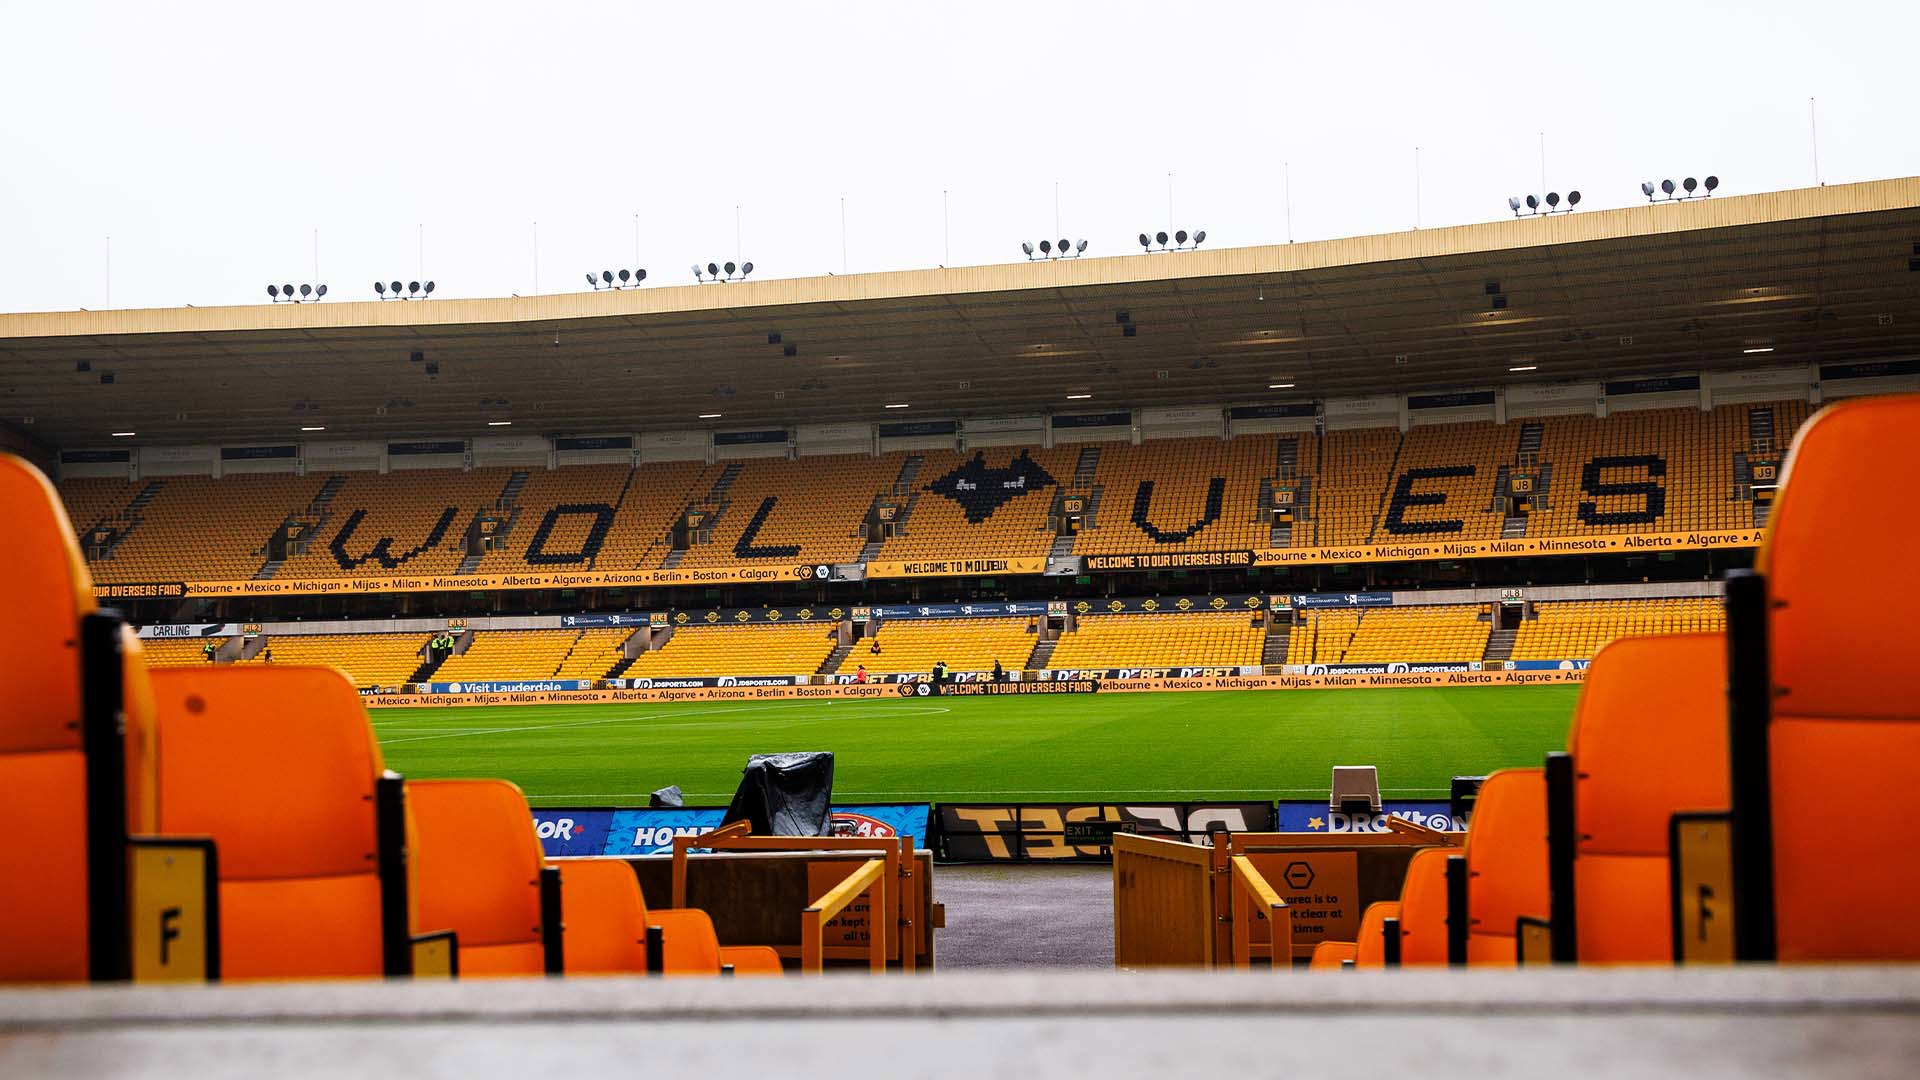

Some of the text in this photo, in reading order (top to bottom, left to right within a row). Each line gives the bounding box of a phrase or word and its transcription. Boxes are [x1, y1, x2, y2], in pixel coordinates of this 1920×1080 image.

[1759, 468, 1772, 477] J9
[1516, 481, 1529, 490] J8
[1279, 493, 1290, 502] J7
[1068, 502, 1079, 511] J6
[883, 509, 894, 518] J5
[485, 522, 495, 532] J3
[1087, 555, 1135, 569] WELCOME
[1137, 555, 1149, 568] TO
[1151, 554, 1170, 567] OUR
[1172, 553, 1222, 567] OVERSEAS
[1223, 551, 1249, 565] FANS
[1320, 549, 1362, 560] Mexico
[1375, 546, 1430, 559] Michigan
[1443, 543, 1476, 556] Mijas
[1490, 542, 1525, 553] Milan
[1539, 539, 1606, 551] Minnesota
[1624, 535, 1672, 547] Alberta
[1686, 533, 1738, 547] Algarve
[904, 562, 948, 574] WELCOME
[951, 561, 962, 572] TO
[93, 585, 110, 597] OUR
[111, 584, 158, 597] OVERSEAS
[158, 584, 182, 596] FANS
[244, 583, 281, 592] Mexico
[293, 581, 340, 592] Michigan
[352, 580, 381, 592] Mijas
[392, 579, 421, 588] Milan
[433, 577, 488, 587] Minnesota
[502, 576, 541, 585] Alberta
[552, 575, 592, 587] Algarve
[603, 573, 642, 583] Arizona
[653, 572, 682, 582] Berlin
[693, 570, 728, 580] Boston
[739, 568, 779, 580] Calgary
[153, 625, 190, 636] CARLING
[1328, 666, 1385, 676] JDSPORTS.COM
[1409, 664, 1468, 674] JDSPORTS.COM
[464, 681, 562, 693] Visit Lauderdale
[652, 679, 704, 689] JDSPORTS.COM
[737, 678, 788, 687] JDSPORTS.COM
[940, 684, 985, 695] WELCOME
[986, 683, 998, 694] TO
[1000, 682, 1018, 694] OUR
[1019, 682, 1066, 694] OVERSEAS
[1068, 680, 1092, 692] FANS
[1163, 680, 1203, 689] Mexico
[1215, 678, 1268, 690] Michigan
[1280, 677, 1312, 688] Mijas
[1324, 676, 1357, 686] Milan
[1370, 675, 1432, 685] Minnesota
[1448, 674, 1492, 683] Alberta
[1505, 673, 1551, 684] Algarve
[377, 697, 410, 705] Mexico
[420, 695, 464, 706] Michigan
[474, 694, 500, 705] Mijas
[510, 693, 537, 702] Milan
[548, 692, 599, 701] Minnesota
[612, 692, 648, 700] Alberta
[659, 690, 696, 701] Algarve
[707, 689, 745, 698] Arizona
[756, 688, 785, 697] Berlin
[796, 687, 832, 696] Boston
[843, 686, 883, 697] Calgary
[1066, 825, 1093, 836] EXIT
[1286, 894, 1338, 905] area is to
[1300, 908, 1328, 919] clear
[1330, 908, 1343, 919] at
[1699, 882, 1715, 943] F
[841, 918, 865, 930] kept
[1293, 923, 1325, 934] times
[160, 907, 181, 967] F
